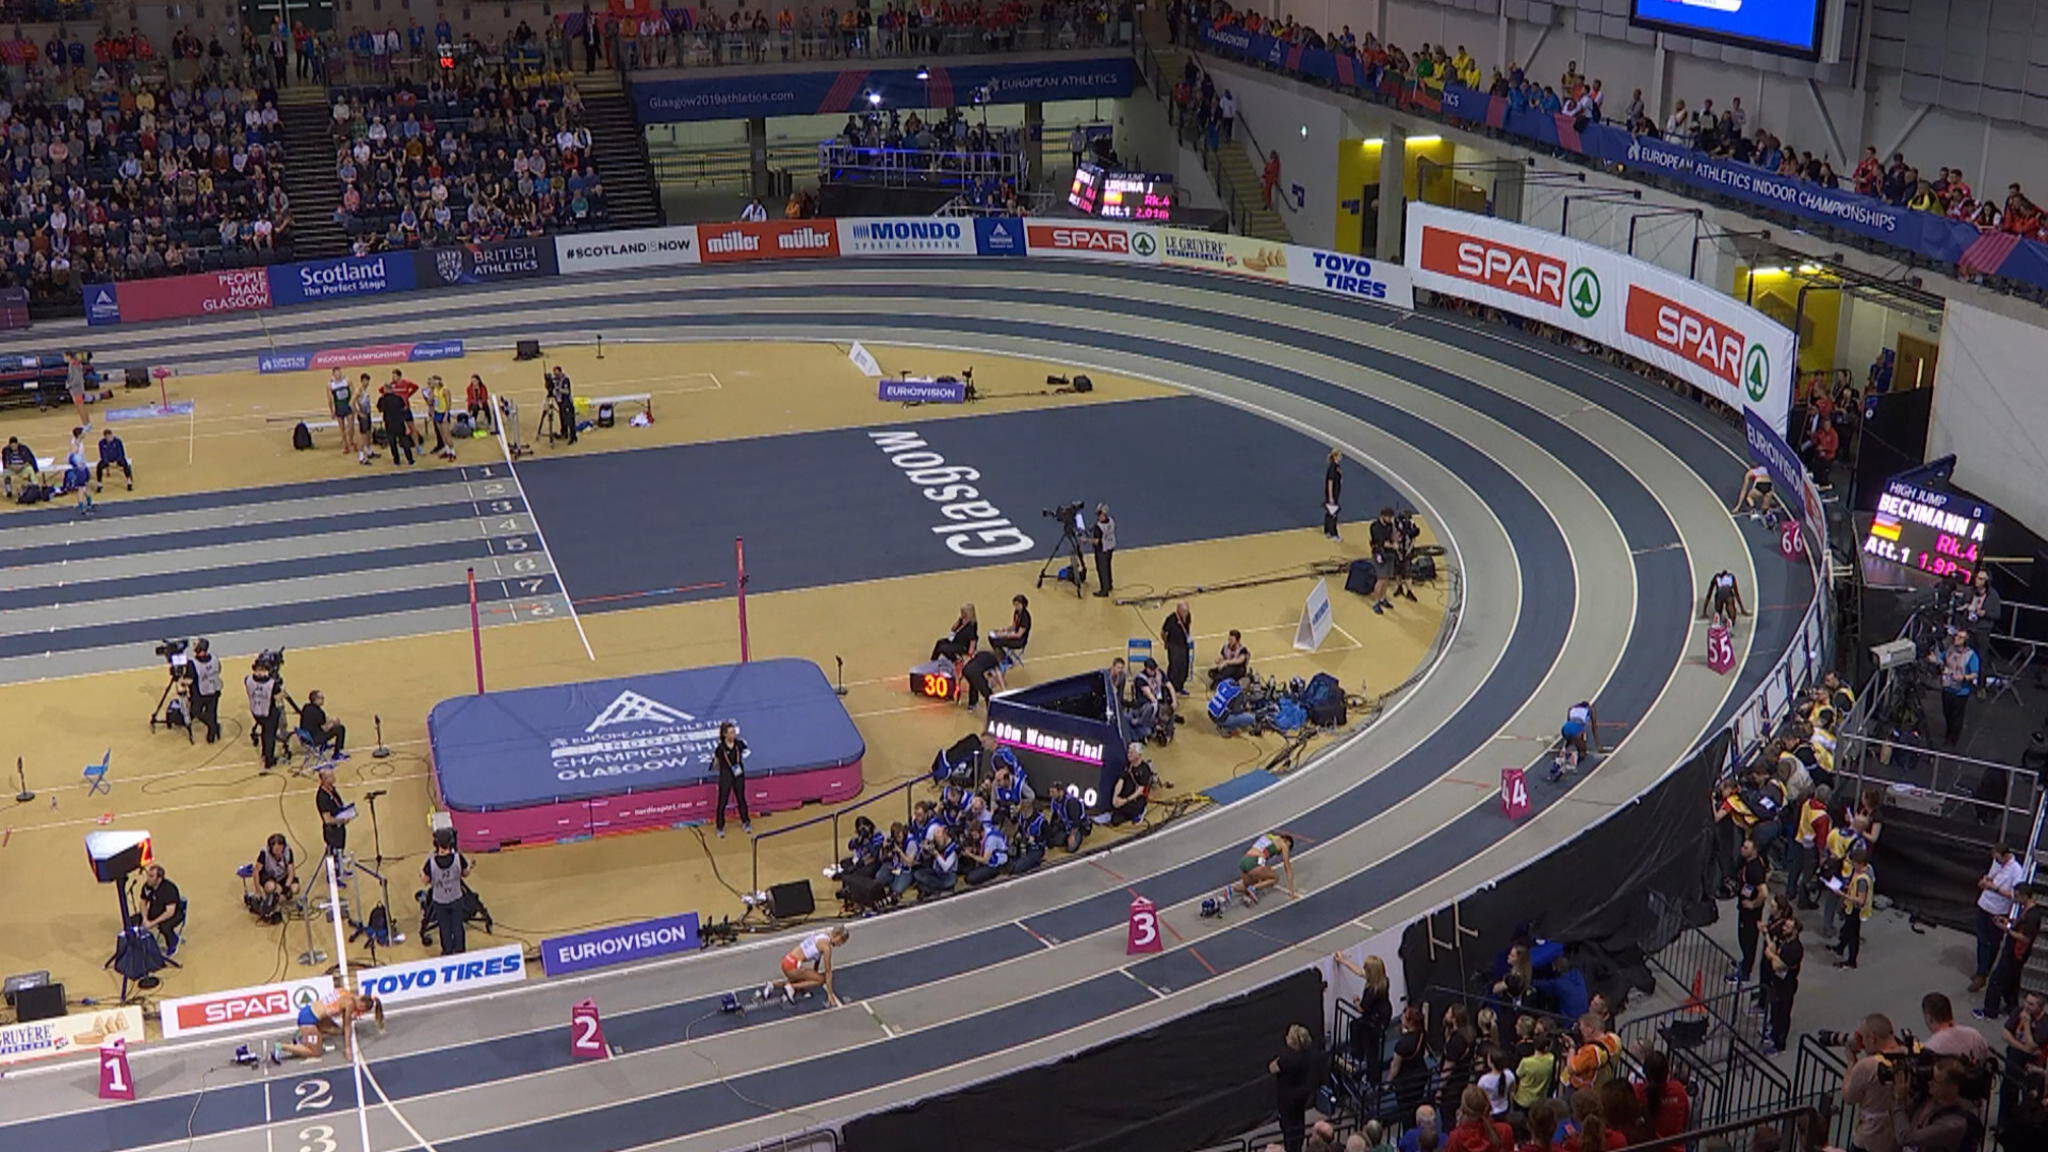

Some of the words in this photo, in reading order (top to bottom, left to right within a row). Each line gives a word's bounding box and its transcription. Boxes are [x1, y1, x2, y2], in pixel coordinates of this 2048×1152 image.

[1002, 77, 1059, 90] EUROPEAN
[1062, 73, 1118, 86] ATHLETICS
[649, 91, 794, 109] Glasgow2019athletics.com
[1641, 146, 1693, 175] EUROPEAN
[1695, 163, 1750, 190] ATHLETICS
[1752, 178, 1797, 203] INDOOR
[1799, 191, 1897, 232] CHAMPIONSHIPS
[1101, 205, 1130, 217] Att.1
[707, 231, 761, 254] müller
[778, 227, 832, 250] müller
[871, 222, 961, 240] MONDO
[1053, 229, 1128, 252] SPAR
[1165, 235, 1177, 248] LE
[474, 247, 536, 264] BRITISH
[1312, 252, 1372, 278] TOYO
[218, 271, 267, 287] PEOPLE
[300, 258, 385, 287] Scotland
[474, 261, 539, 276] ATHLETICS
[1457, 242, 1562, 301] SPAR
[231, 281, 267, 297] MAKE
[304, 287, 321, 297] The
[323, 282, 357, 295] Perfect
[358, 279, 386, 293] Stage
[1324, 271, 1388, 299] TIRES
[203, 293, 269, 313] GLASGOW
[1656, 304, 1743, 380] SPAR
[480, 467, 495, 478] 1
[867, 431, 1036, 558] Glasgow
[1889, 482, 1918, 500] HIGH
[1916, 487, 1948, 507] JUMP
[499, 518, 517, 530] 4
[1878, 492, 1970, 537] BECHMANN
[1971, 522, 1985, 542] A
[505, 537, 528, 551] 5
[1864, 535, 1911, 564] Att.1
[1935, 532, 1978, 563] Rk.4
[514, 557, 536, 572] 6
[519, 578, 543, 593] 7
[924, 673, 948, 697] 30
[571, 727, 653, 744] EUROPEAN
[1026, 727, 1068, 753] Women
[1072, 738, 1104, 761] Final
[557, 756, 688, 781] GLASGOW
[1512, 779, 1528, 808] 4
[1132, 911, 1156, 946] 3
[361, 970, 437, 997] TOYO
[441, 953, 522, 985] TIRES
[205, 993, 288, 1023] SPAR
[0, 1023, 52, 1046] RUYÈRE
[574, 1015, 600, 1049] 2
[104, 1057, 128, 1091] 1
[294, 1079, 334, 1112] 2
[299, 1124, 338, 1152] 3
